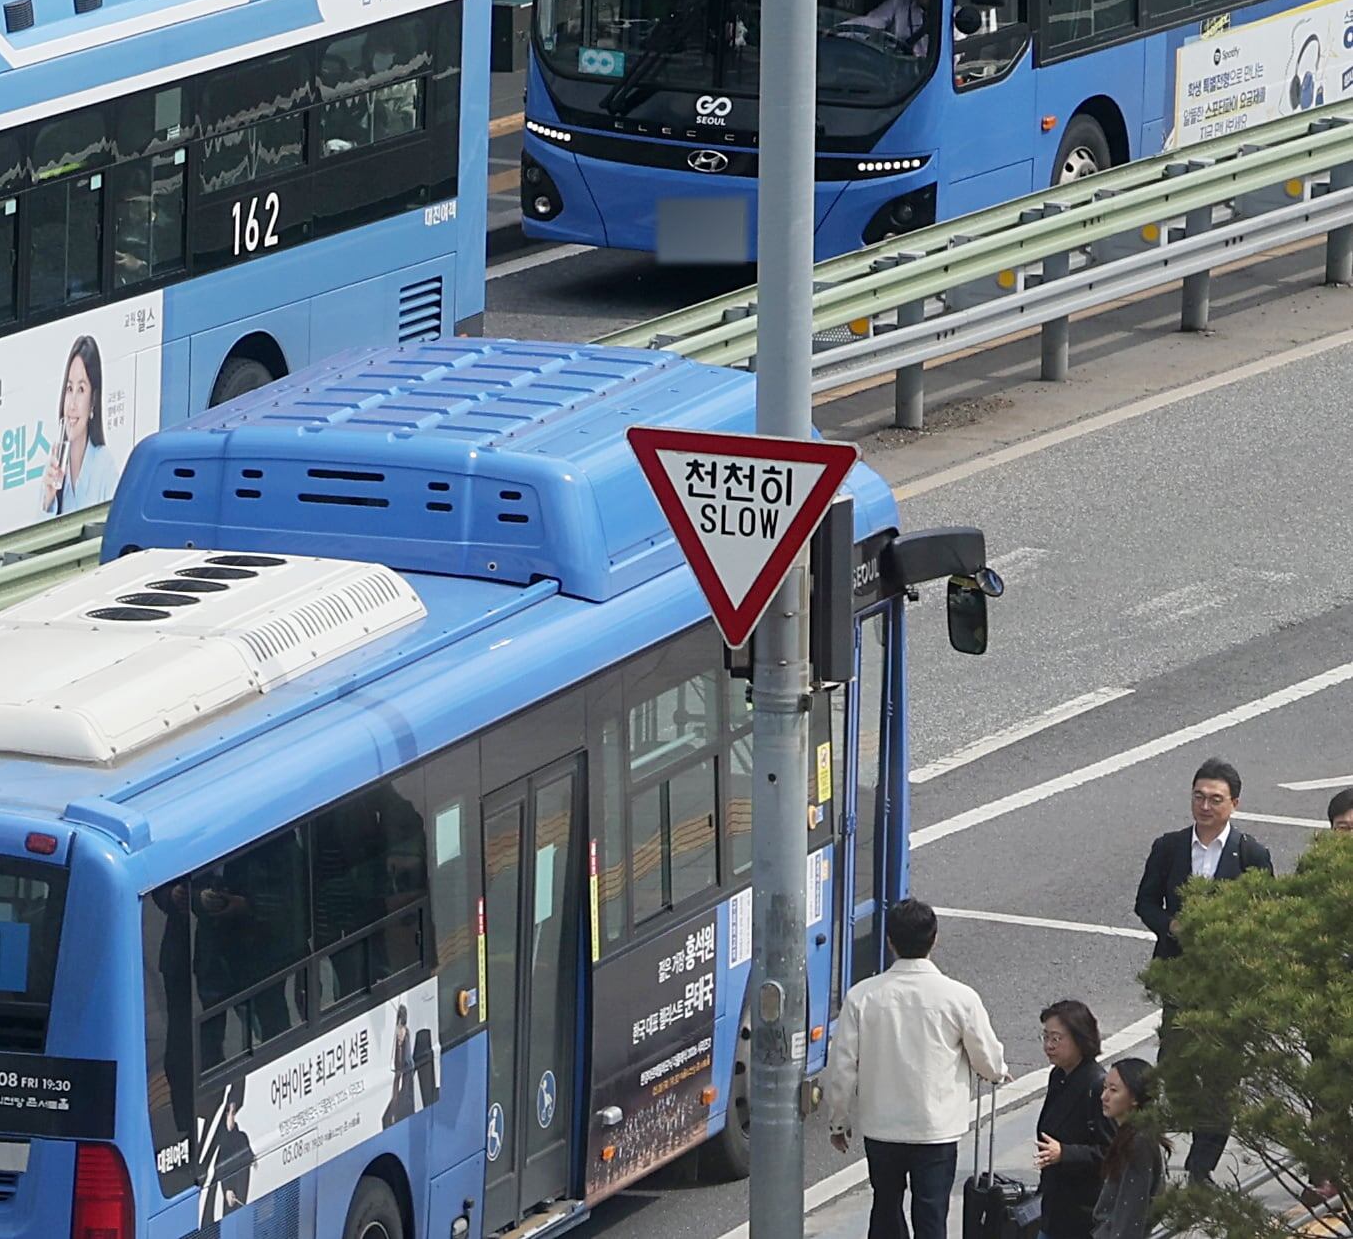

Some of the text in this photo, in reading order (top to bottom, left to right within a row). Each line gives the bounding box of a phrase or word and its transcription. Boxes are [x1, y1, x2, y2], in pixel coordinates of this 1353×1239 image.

[695, 115, 727, 127] SEOUL
[231, 191, 280, 256] 162
[685, 458, 793, 507] 천천히
[700, 503, 779, 539] SLOW
[685, 922, 715, 971] 홍석원
[683, 972, 714, 1019] 문태국
[20, 1076, 40, 1090] FRI
[42, 1078, 72, 1093] 19:30
[270, 1028, 370, 1110] 어버이날 최고의 선물
[156, 1138, 190, 1175] 대원여객
